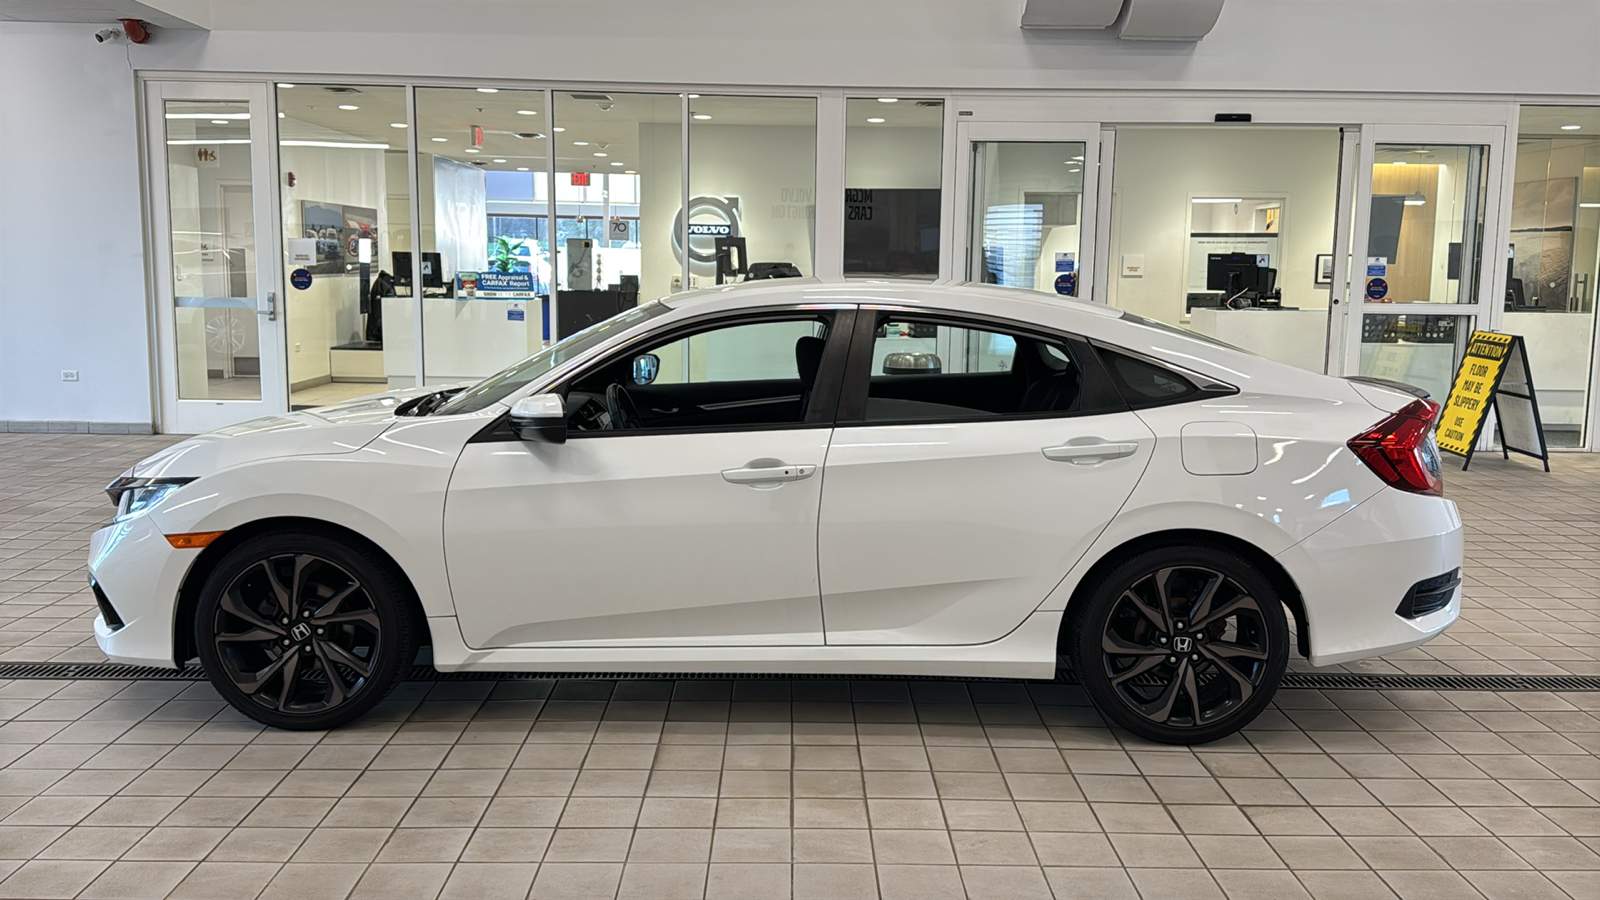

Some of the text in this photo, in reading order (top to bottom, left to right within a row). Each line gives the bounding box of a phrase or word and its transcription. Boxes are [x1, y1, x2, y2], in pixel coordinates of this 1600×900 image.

[573, 173, 589, 186] EXIT
[611, 222, 627, 233] 70
[688, 225, 730, 234] VOLVO
[1471, 343, 1503, 359] ATTENTION
[1469, 363, 1489, 377] FLOOR
[1462, 379, 1484, 394] MAY BE
[1453, 394, 1481, 411] SLIPPERY
[1454, 416, 1465, 428] USE
[1444, 428, 1465, 442] CAUTION
